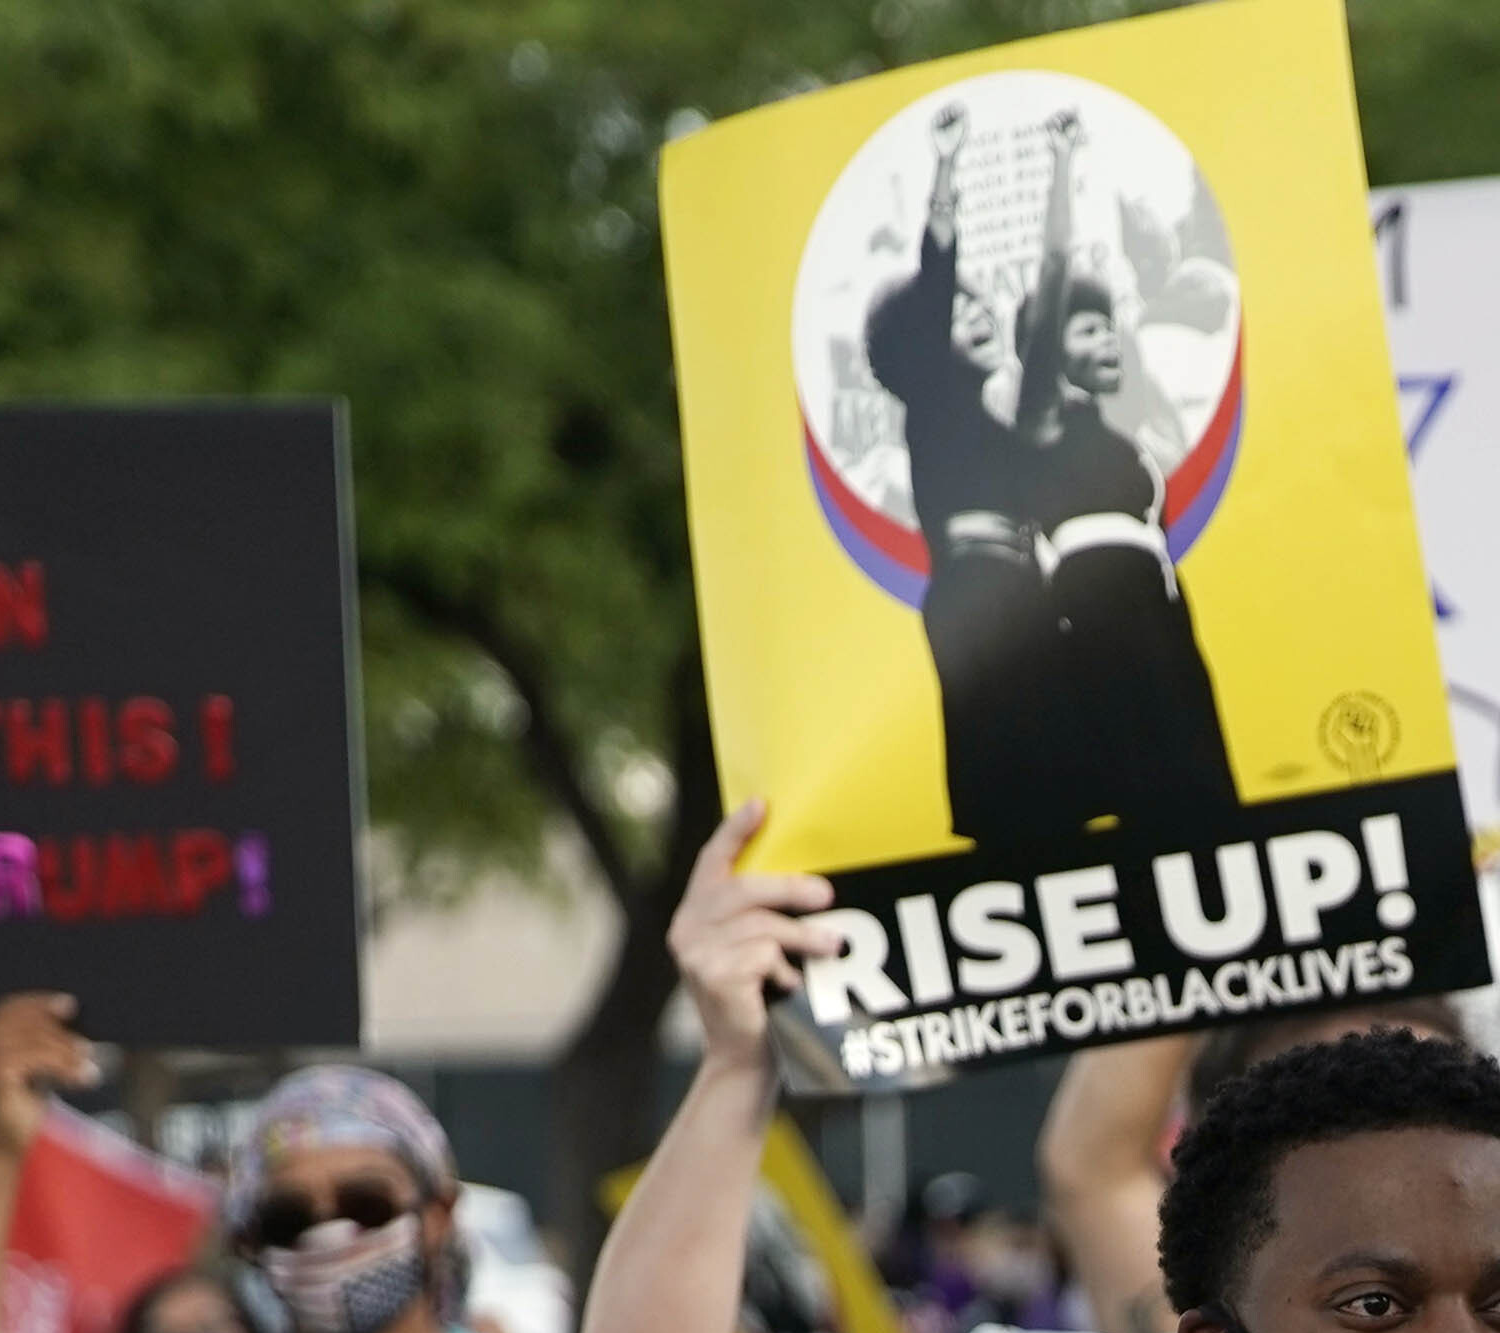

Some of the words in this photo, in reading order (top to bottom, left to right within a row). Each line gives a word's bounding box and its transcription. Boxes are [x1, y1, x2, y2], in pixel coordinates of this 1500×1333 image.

[803, 863, 1136, 1027] RISE
[1150, 812, 1417, 960] UP!
[839, 936, 1415, 1080] #STRIKEFORBLACKLIVES
